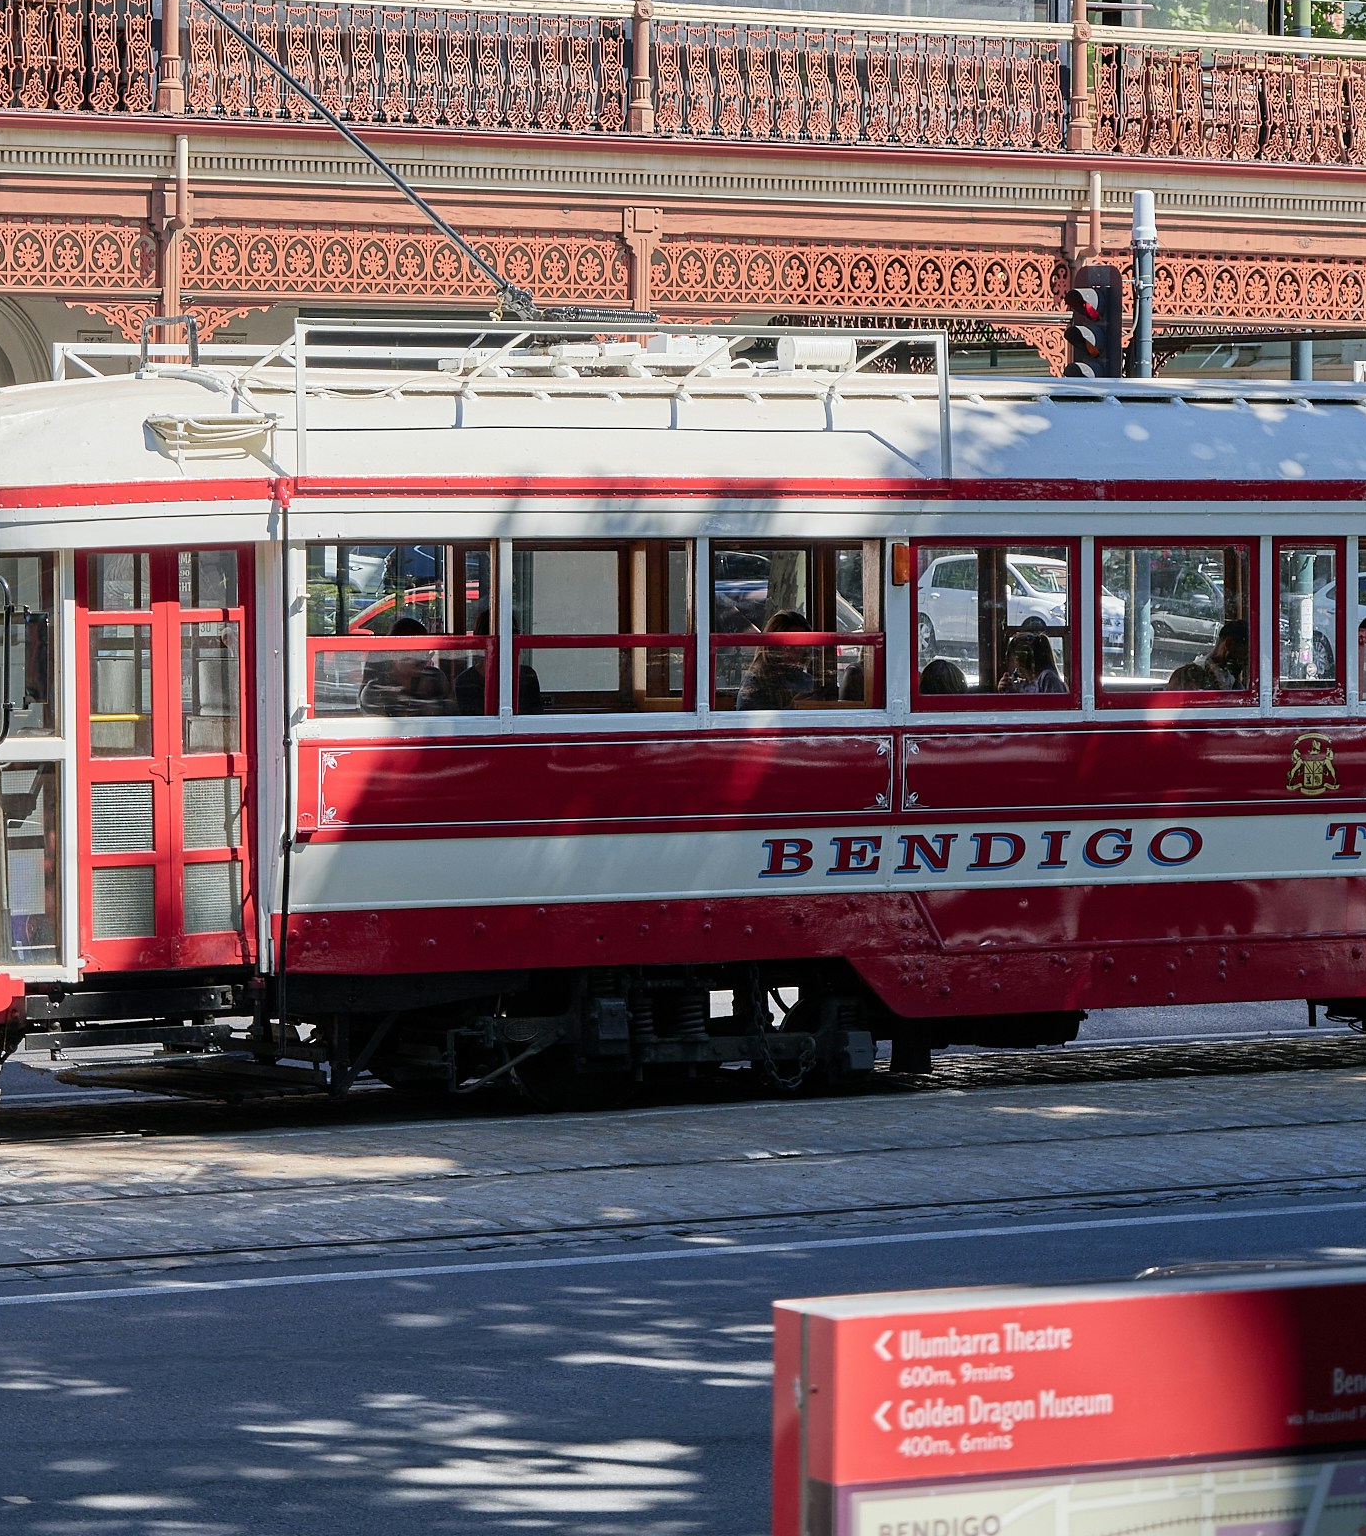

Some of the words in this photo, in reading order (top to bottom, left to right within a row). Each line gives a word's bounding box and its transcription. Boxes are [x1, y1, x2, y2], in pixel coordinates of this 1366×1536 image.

[758, 825, 1204, 880] BENDIGO
[899, 1328, 999, 1361] Ulumbarra
[1002, 1322, 1073, 1354] Theatre
[899, 1365, 956, 1389] 600m,
[960, 1362, 1015, 1384] 9mins
[899, 1400, 965, 1431] Golden
[969, 1395, 1035, 1431] Dragon
[1039, 1389, 1114, 1419] Museum
[898, 1436, 956, 1458] 400m,
[960, 1432, 1014, 1455] 6mins
[878, 1516, 1002, 1536] BENDIGO
